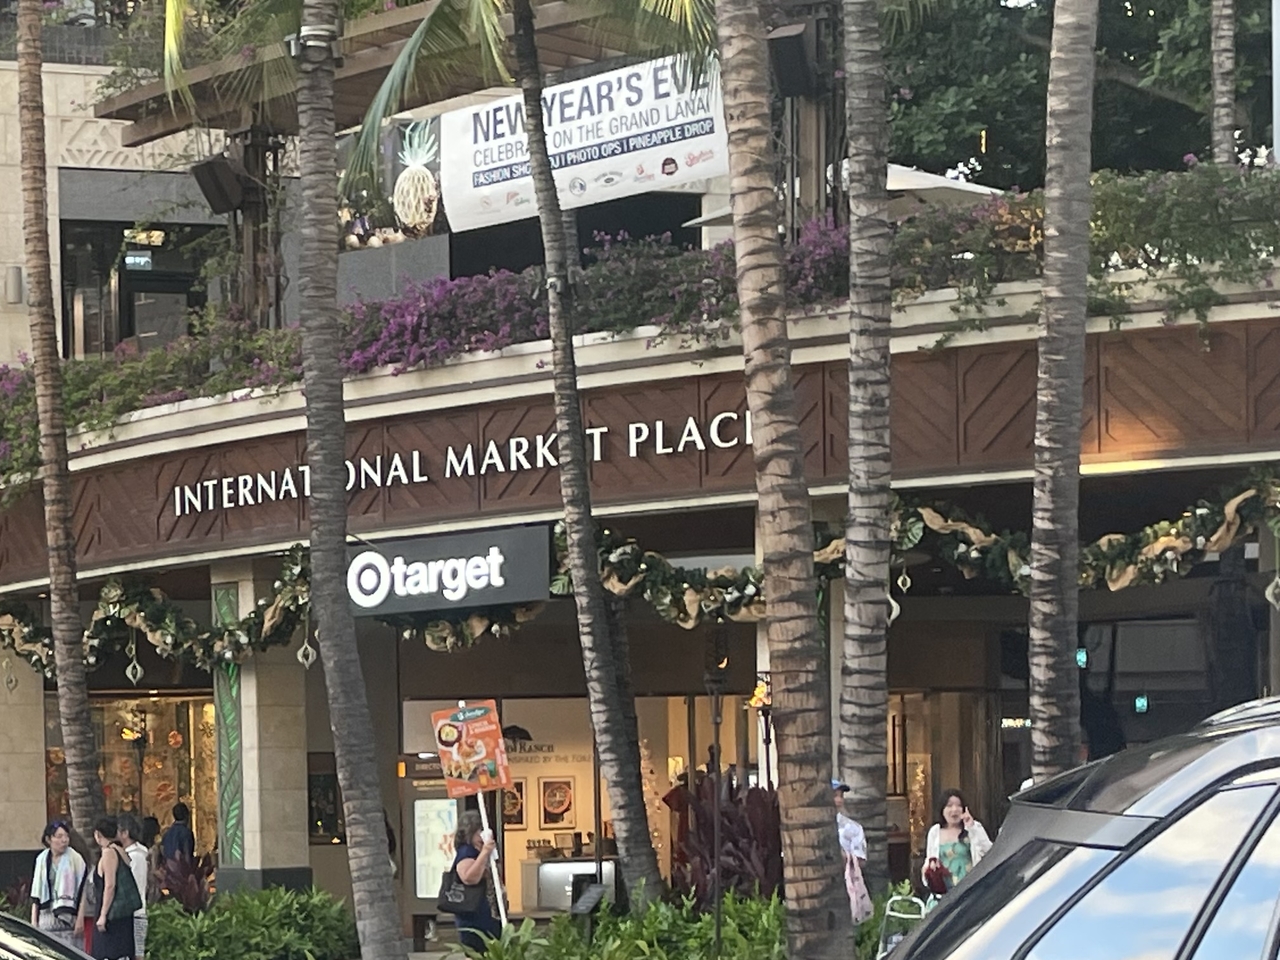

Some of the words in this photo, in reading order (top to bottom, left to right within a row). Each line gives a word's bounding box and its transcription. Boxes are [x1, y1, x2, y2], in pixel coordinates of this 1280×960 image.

[542, 72, 644, 128] YEAR'S
[473, 140, 530, 168] CELEBR
[552, 128, 573, 149] ON
[577, 119, 605, 144] THE
[609, 107, 660, 135] GRAND
[473, 167, 511, 187] FASHION
[512, 161, 531, 178] SHO
[566, 145, 600, 165] PHOTO
[601, 141, 622, 157] OPS
[629, 126, 683, 151] PINEAPPLE
[684, 120, 713, 137] DROP
[174, 449, 428, 517] INTERNATNAL
[445, 426, 608, 479] MARKT
[390, 546, 505, 601] target
